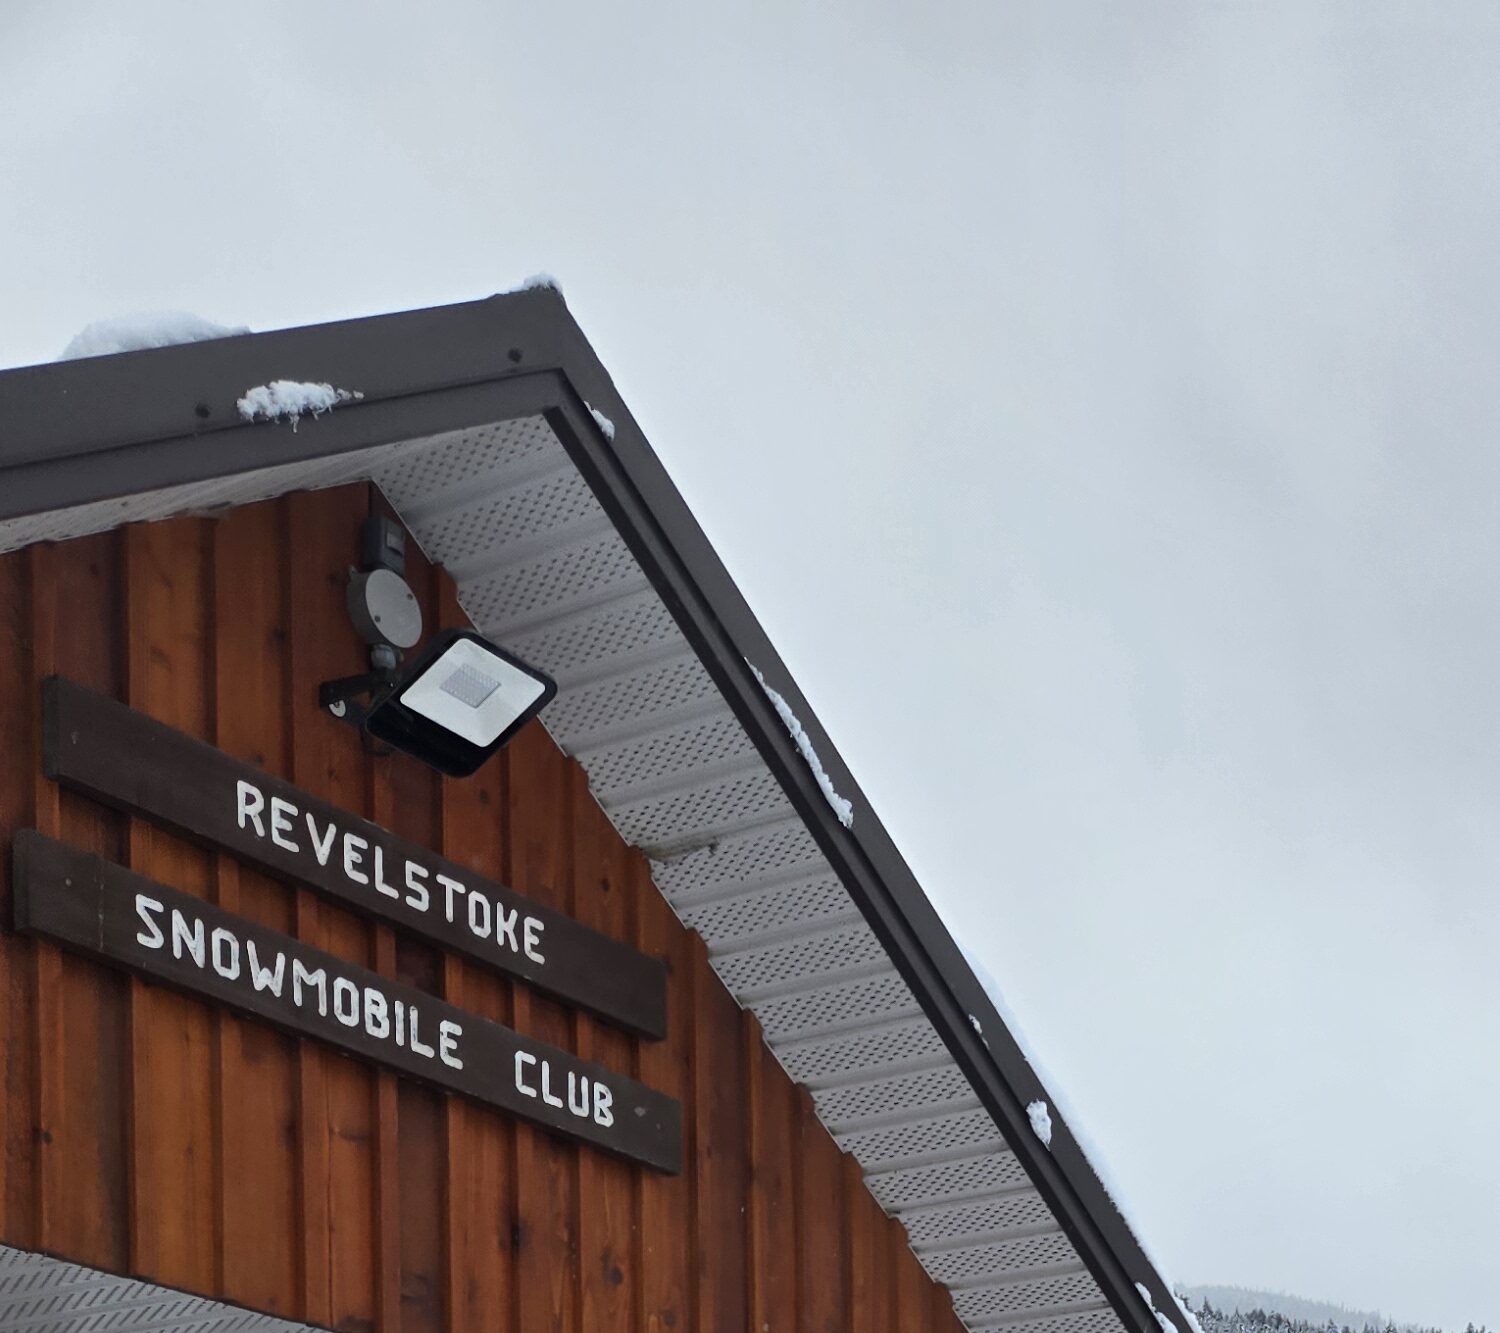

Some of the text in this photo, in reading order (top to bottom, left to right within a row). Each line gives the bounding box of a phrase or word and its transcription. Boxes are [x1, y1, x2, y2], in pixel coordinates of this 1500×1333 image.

[236, 780, 546, 965] REVELSTOKE
[135, 893, 615, 1128] SNOWMOBILE CLUB
